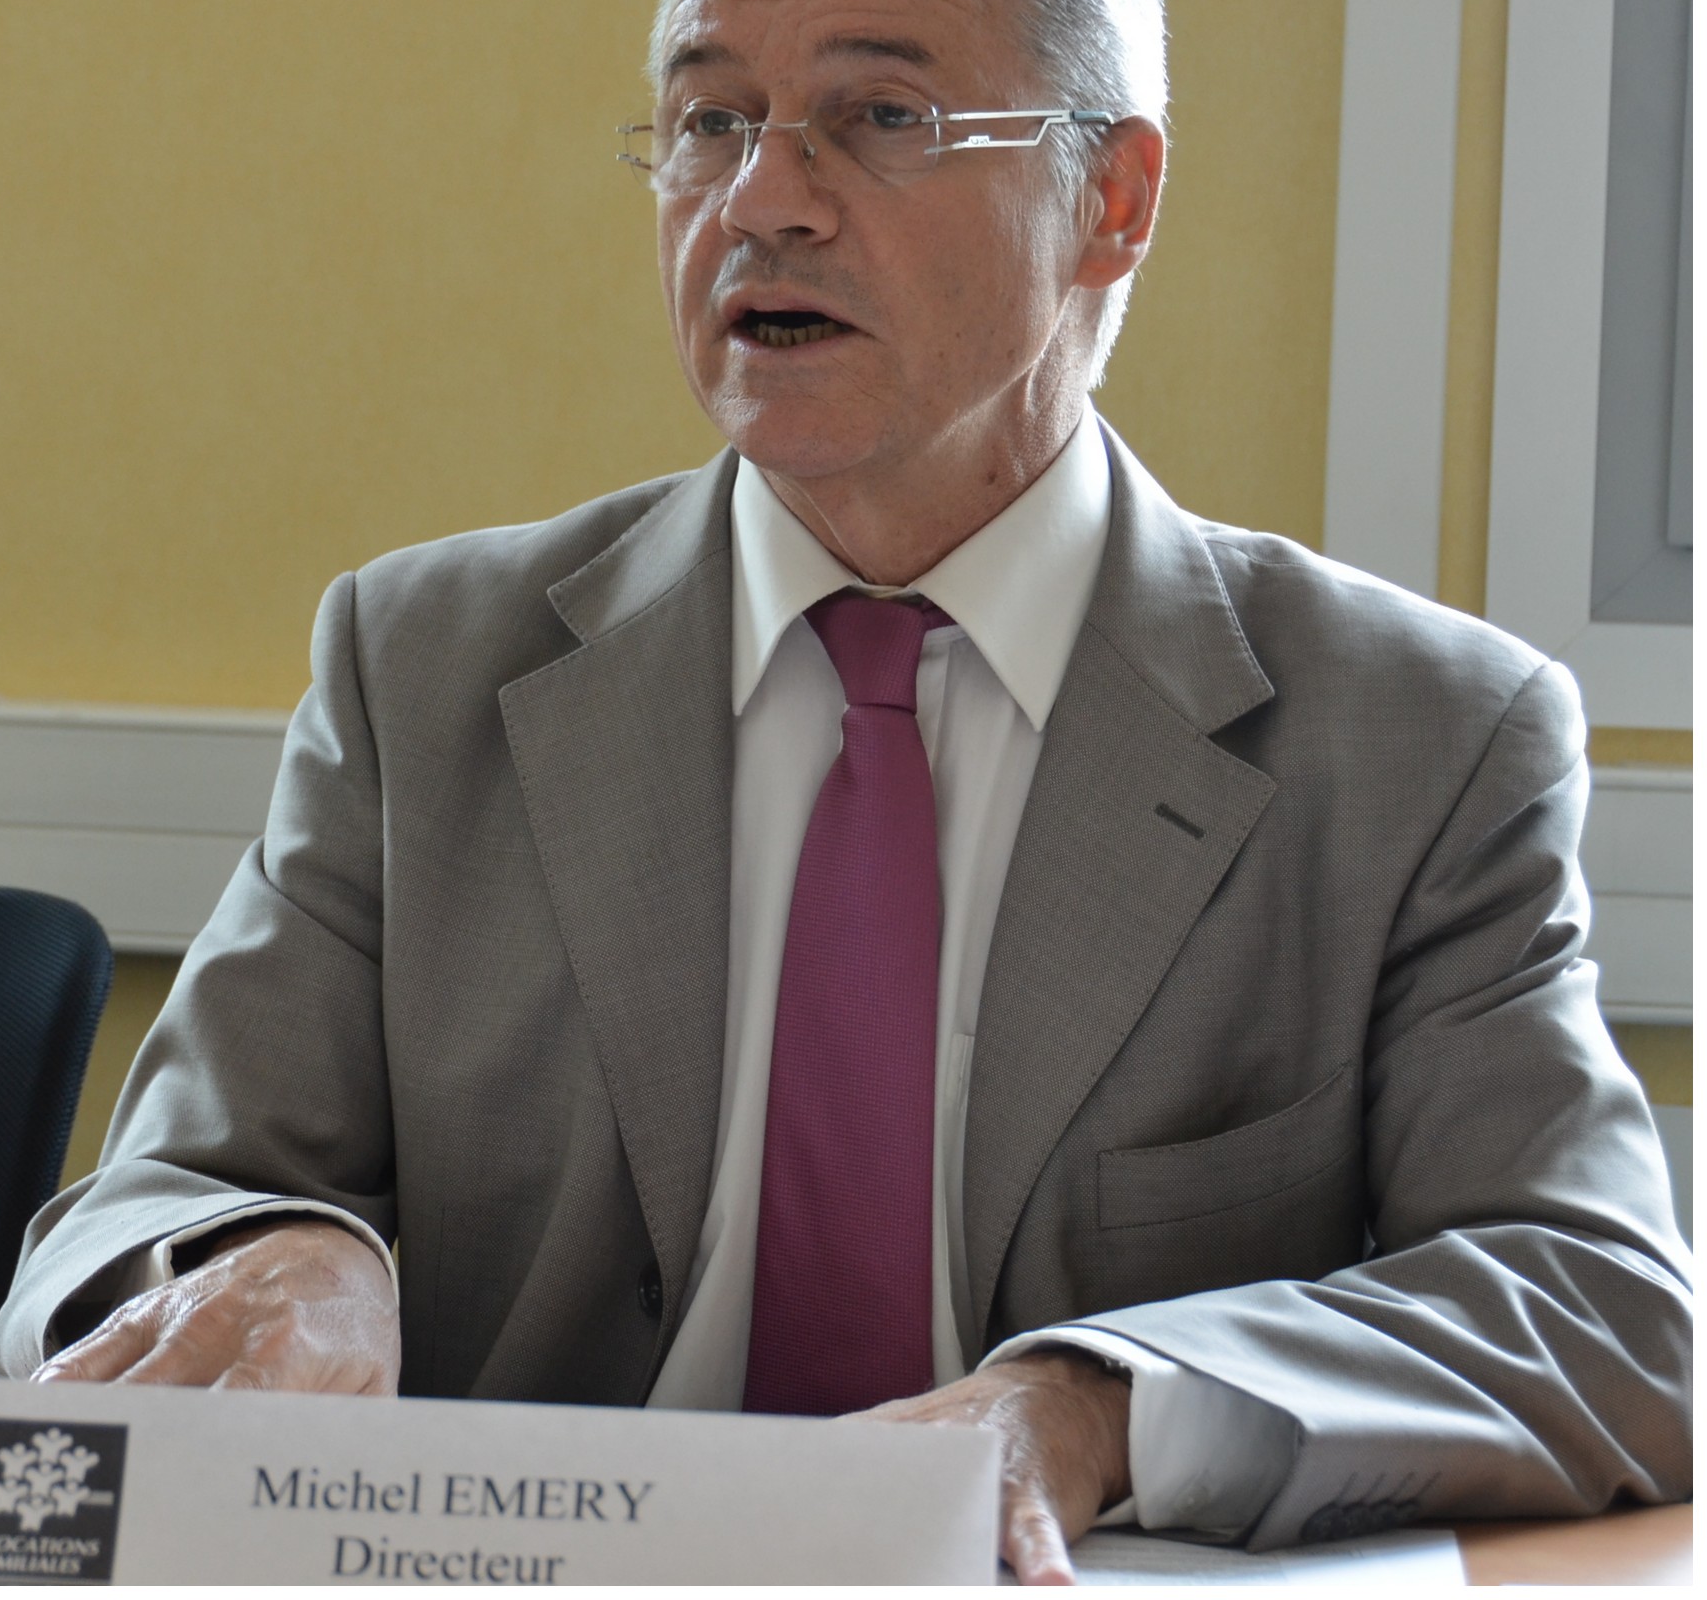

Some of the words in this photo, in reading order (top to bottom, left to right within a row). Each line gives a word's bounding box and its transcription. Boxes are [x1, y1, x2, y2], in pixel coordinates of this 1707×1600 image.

[249, 1466, 422, 1516] Michel
[442, 1473, 656, 1523] EMERY
[331, 1534, 566, 1586] Directeur
